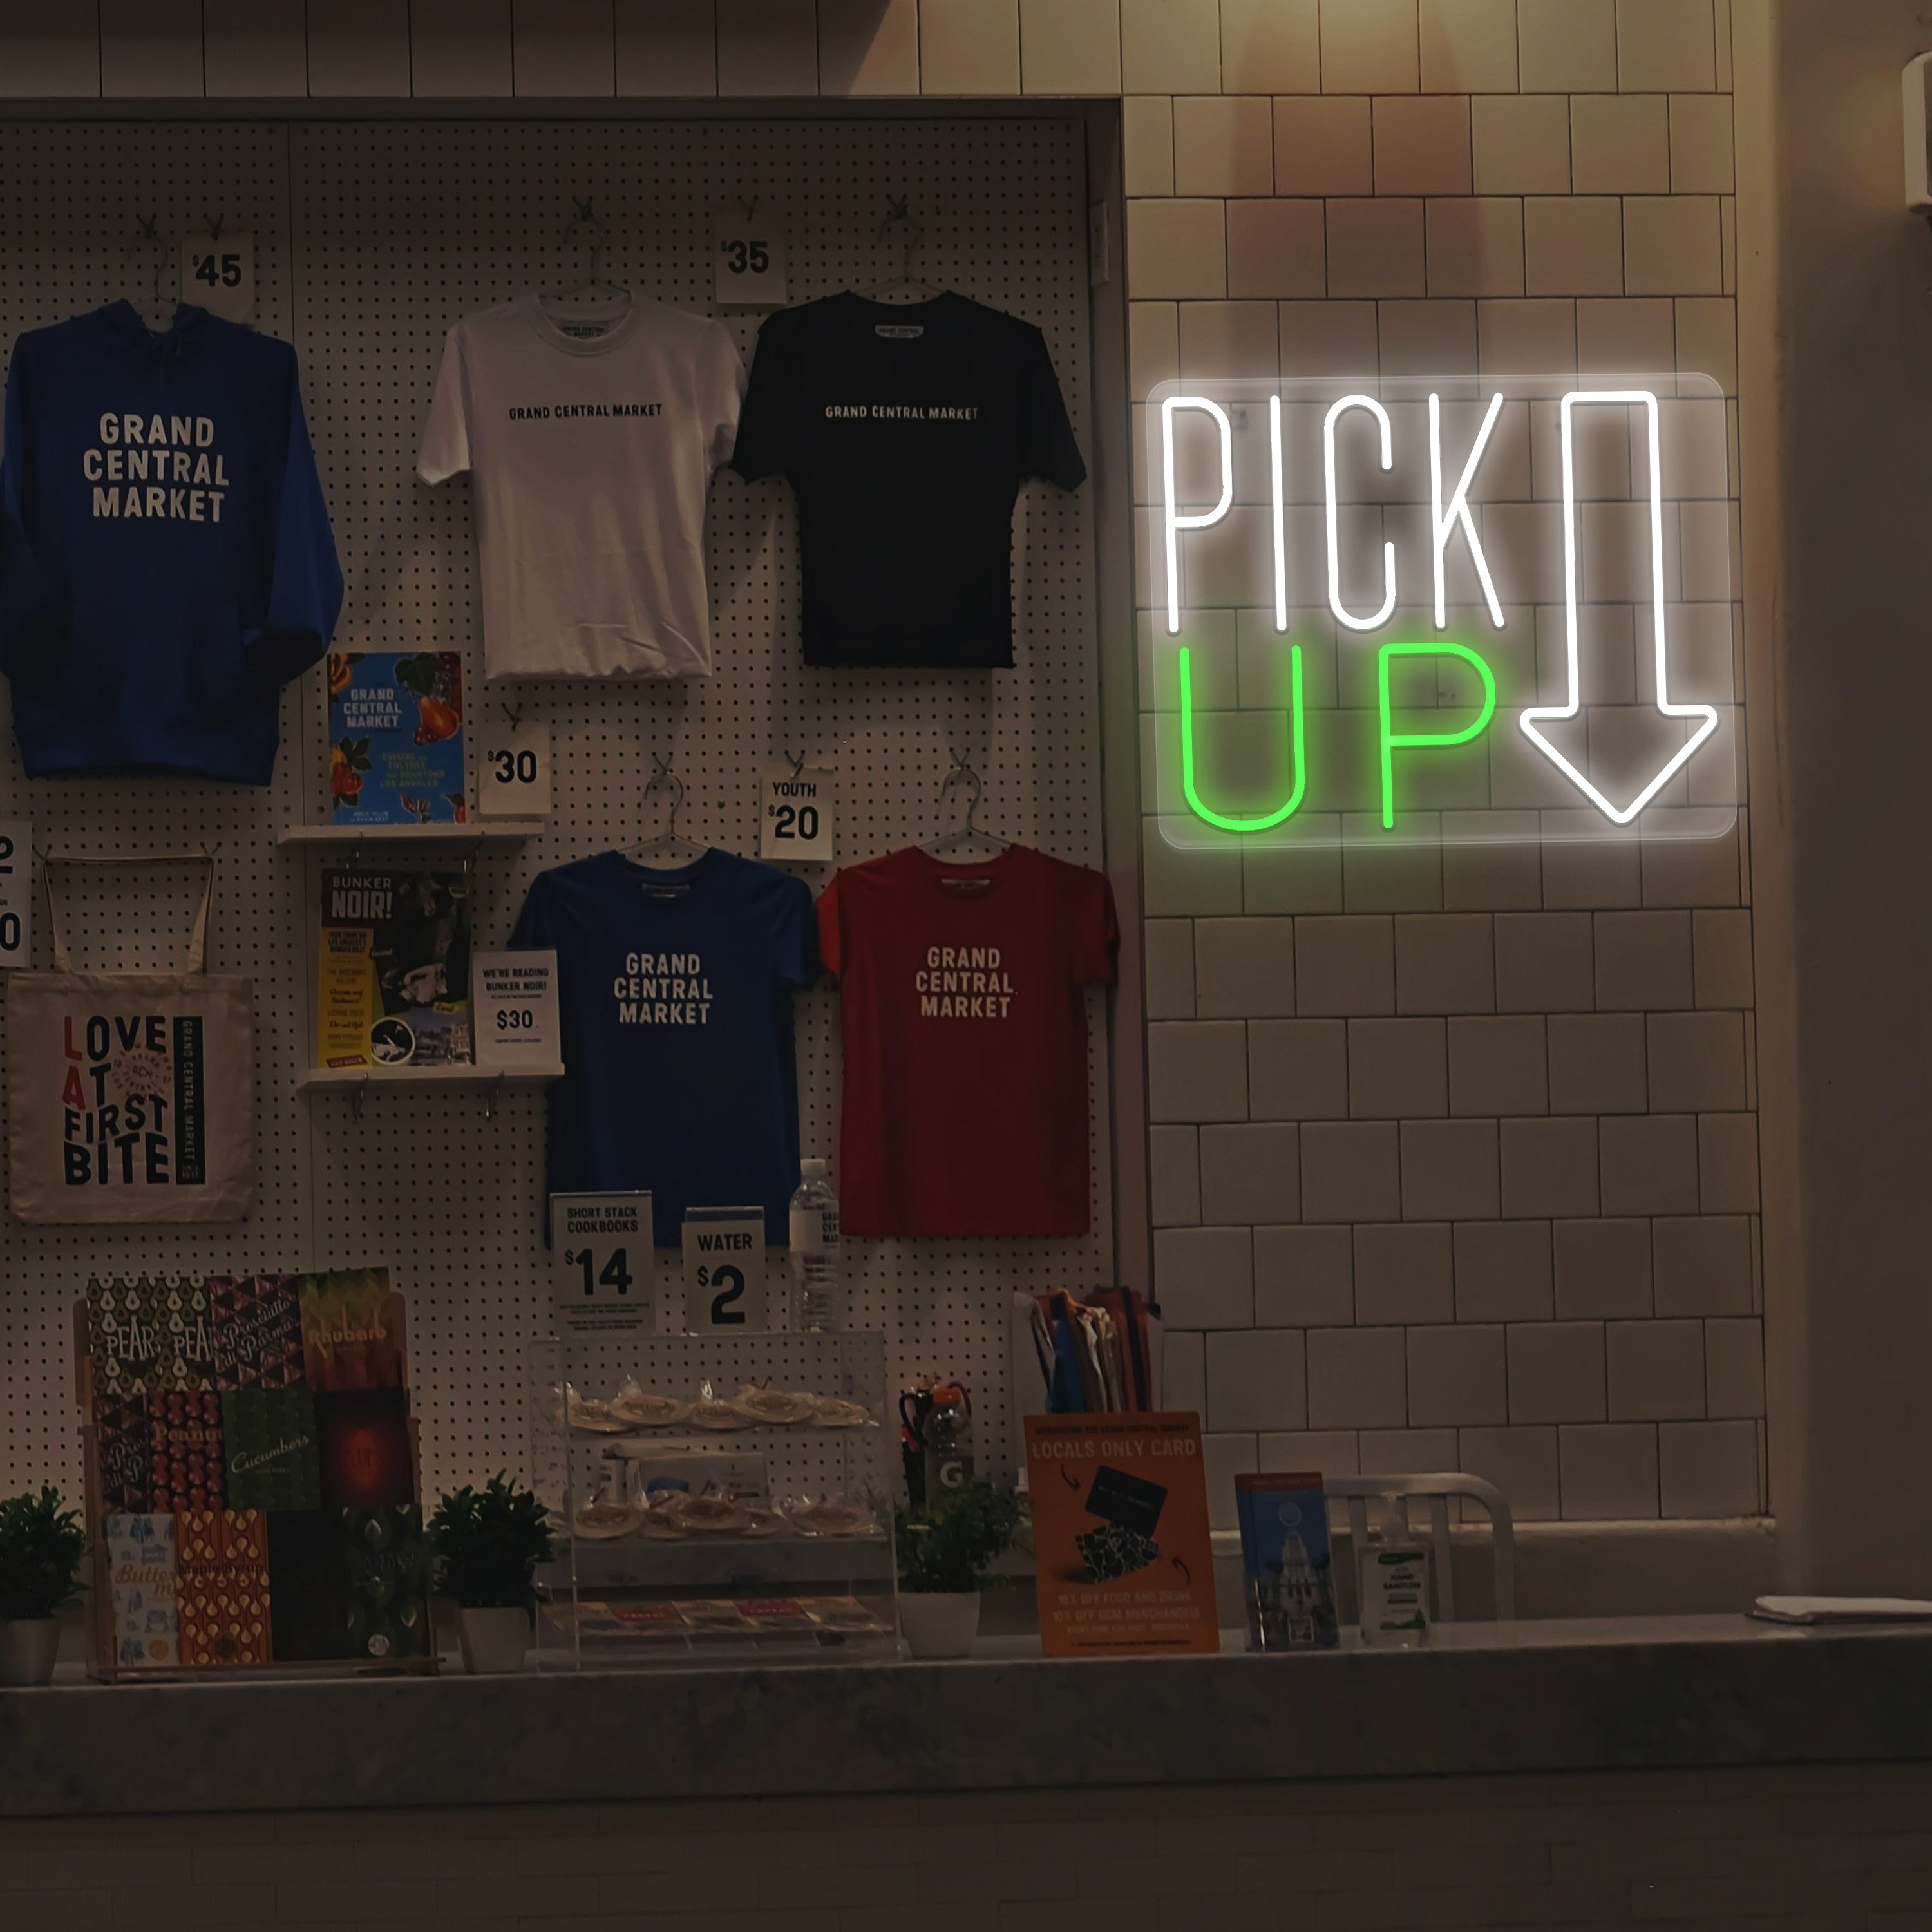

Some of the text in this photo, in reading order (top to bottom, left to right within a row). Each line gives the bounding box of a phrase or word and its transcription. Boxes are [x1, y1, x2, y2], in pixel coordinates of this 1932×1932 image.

[721, 240, 770, 274] $35
[192, 254, 242, 287] $45
[509, 403, 663, 420] GRAND CENTRAL MARKET
[826, 405, 978, 420] GRAND CENTRAL MARKET
[100, 413, 214, 448] GRAND
[83, 449, 229, 486] CENTRAL
[92, 487, 225, 523] MARKET
[1162, 393, 1504, 632] PICK
[350, 688, 394, 701] GRAND
[343, 702, 402, 715] CENTRAL
[346, 715, 399, 728] MARKET
[1180, 643, 1496, 832] UP
[488, 750, 537, 783] $30
[773, 782, 816, 797] YOUTH
[768, 804, 818, 840] $20
[332, 876, 392, 889] BUNKER
[331, 890, 393, 920] NOIR!
[626, 952, 701, 975] GRAND
[927, 946, 1001, 969] GRAND
[483, 967, 549, 978] WE'RE READING
[916, 971, 1015, 994] CENTRAL
[486, 981, 547, 992] BUNKER NOIR!
[614, 978, 713, 1001] CENTRAL
[618, 1002, 710, 1025] MARKET
[921, 996, 1011, 1019] MARKET
[496, 1009, 533, 1031] $30
[64, 1015, 167, 1062] LOVE
[182, 1020, 193, 1057] GRAND
[62, 1062, 112, 1110] AT
[183, 1062, 194, 1110] CENTRAL
[64, 1092, 169, 1144] FIRST
[184, 1114, 196, 1160] MARKET
[64, 1131, 169, 1186] BITE
[567, 1206, 638, 1218] SHORT STACK
[567, 1220, 639, 1233] COOKBOOKS
[697, 1233, 752, 1251] WATER
[565, 1248, 632, 1295] $14
[697, 1265, 745, 1324] $2
[231, 1435, 310, 1473] Cucumbers
[1032, 1437, 1196, 1460] LOCALS ONLY CARD
[940, 1461, 963, 1488] G
[1081, 1593, 1099, 1604] OFF
[1103, 1591, 1131, 1604] FOOD
[1135, 1591, 1157, 1603] AND
[1075, 1609, 1095, 1622] OFF
